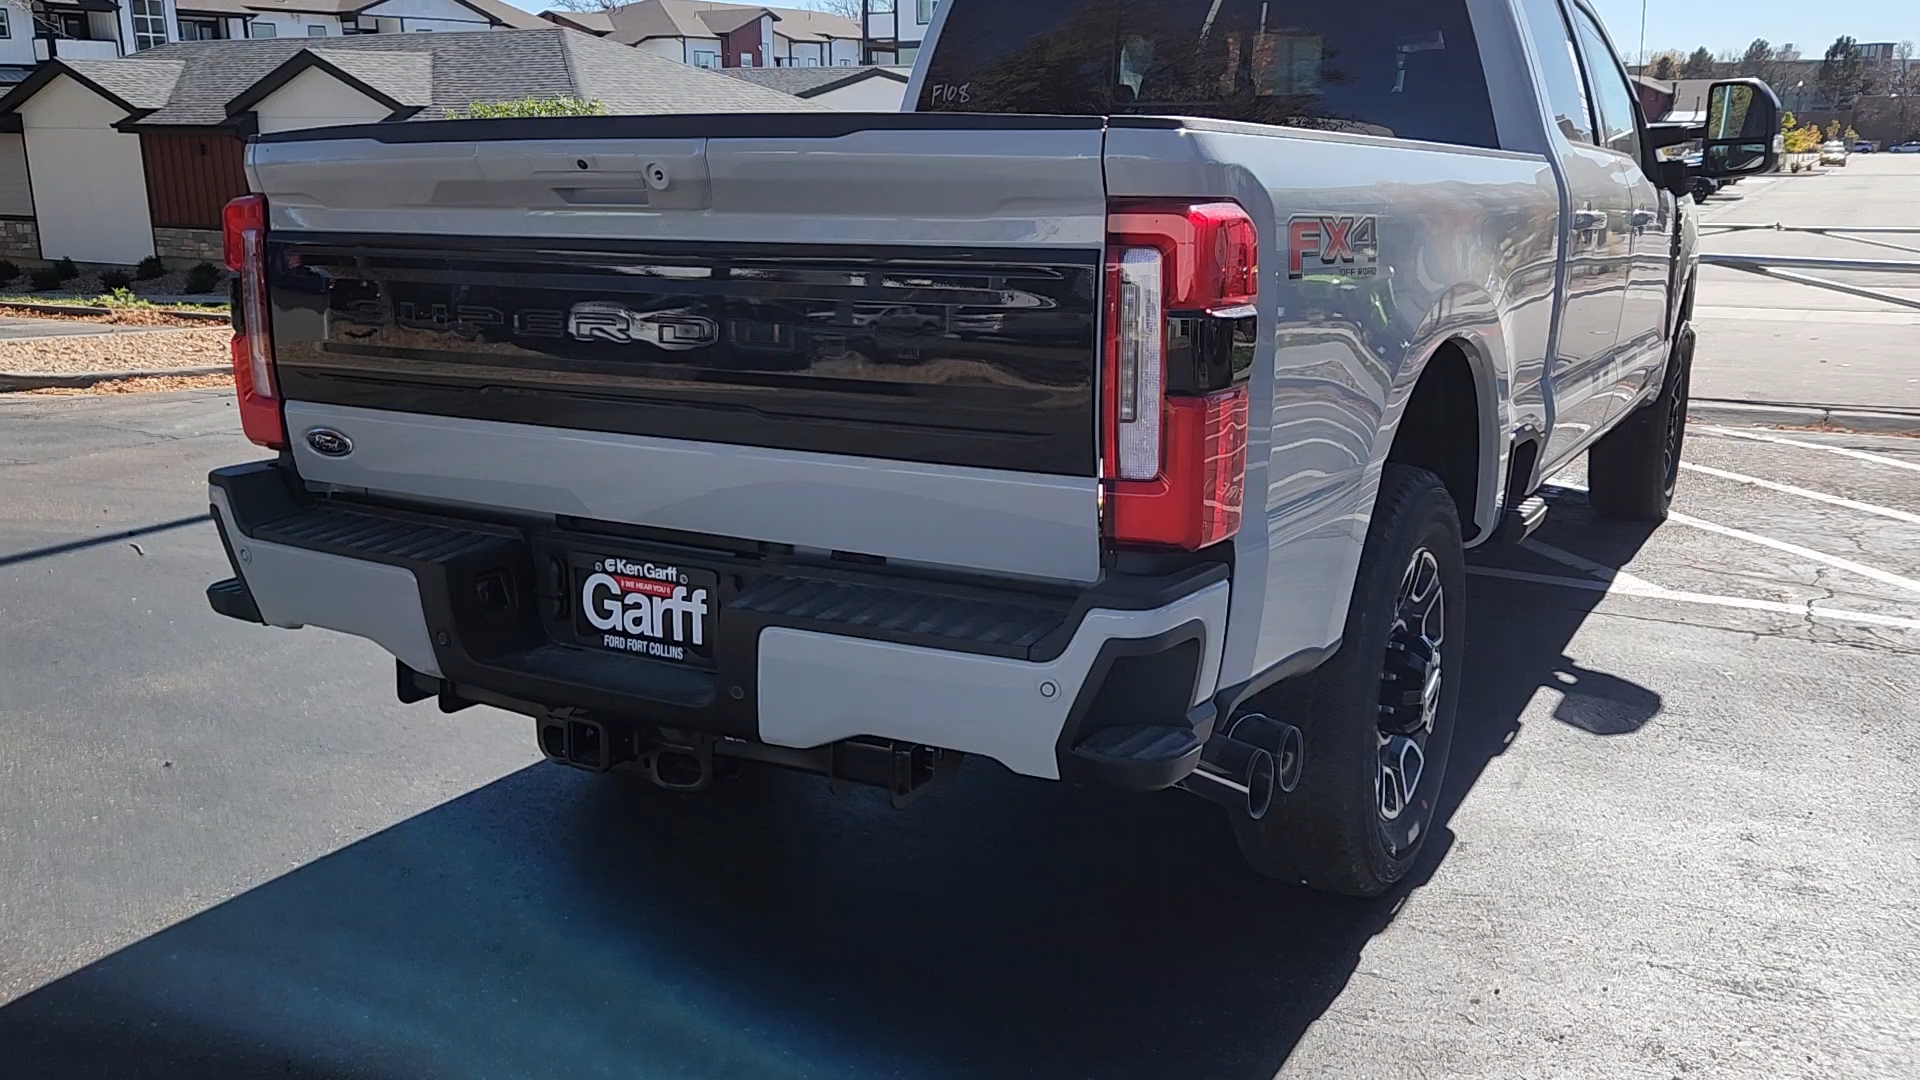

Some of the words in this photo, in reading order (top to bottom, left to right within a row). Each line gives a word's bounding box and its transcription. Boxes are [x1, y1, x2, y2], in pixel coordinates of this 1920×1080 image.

[931, 82, 970, 106] F108
[1288, 213, 1377, 279] FX4
[1340, 268, 1355, 276] OFF
[1357, 267, 1377, 276] ROAD
[315, 434, 340, 451] Ford
[616, 558, 643, 576] Ken
[643, 563, 678, 582] Garff
[635, 582, 652, 591] HEAR
[653, 585, 666, 593] YOU
[583, 573, 708, 645] Garff
[604, 634, 625, 649] FORD
[626, 636, 648, 653] FORT
[650, 641, 684, 660] COLLINS
